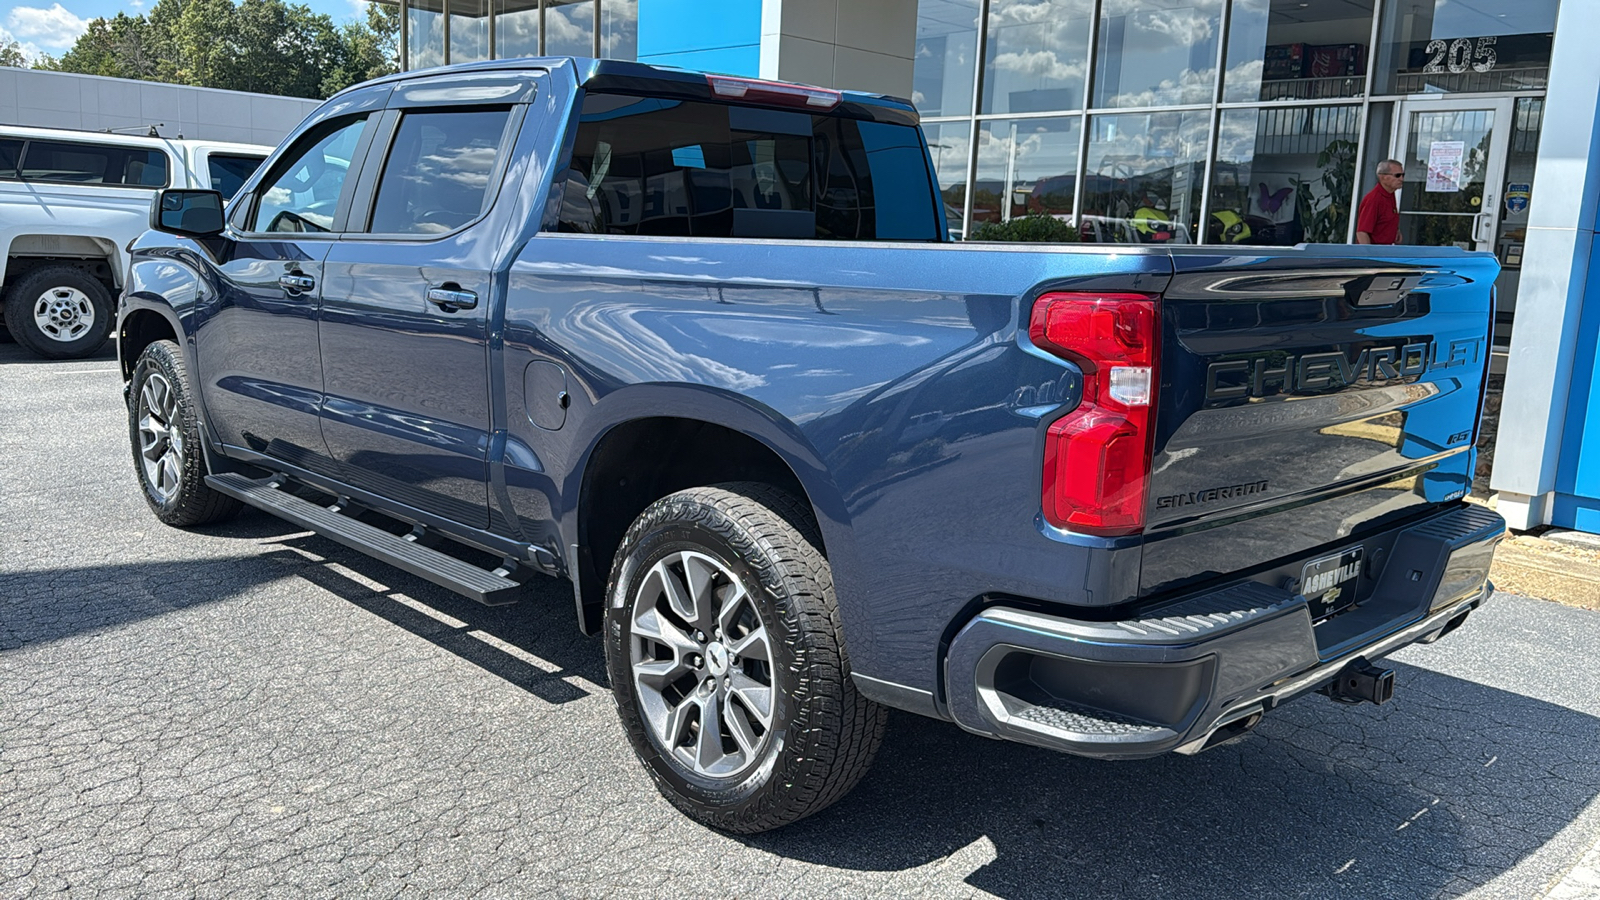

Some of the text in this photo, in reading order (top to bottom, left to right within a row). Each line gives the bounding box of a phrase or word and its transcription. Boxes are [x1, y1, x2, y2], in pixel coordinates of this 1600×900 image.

[1422, 36, 1497, 73] 205
[1205, 335, 1485, 399] CHEVROLET
[1447, 429, 1472, 445] RST
[1156, 480, 1269, 509] SILVERADO
[1303, 560, 1360, 595] ASHEVILLE
